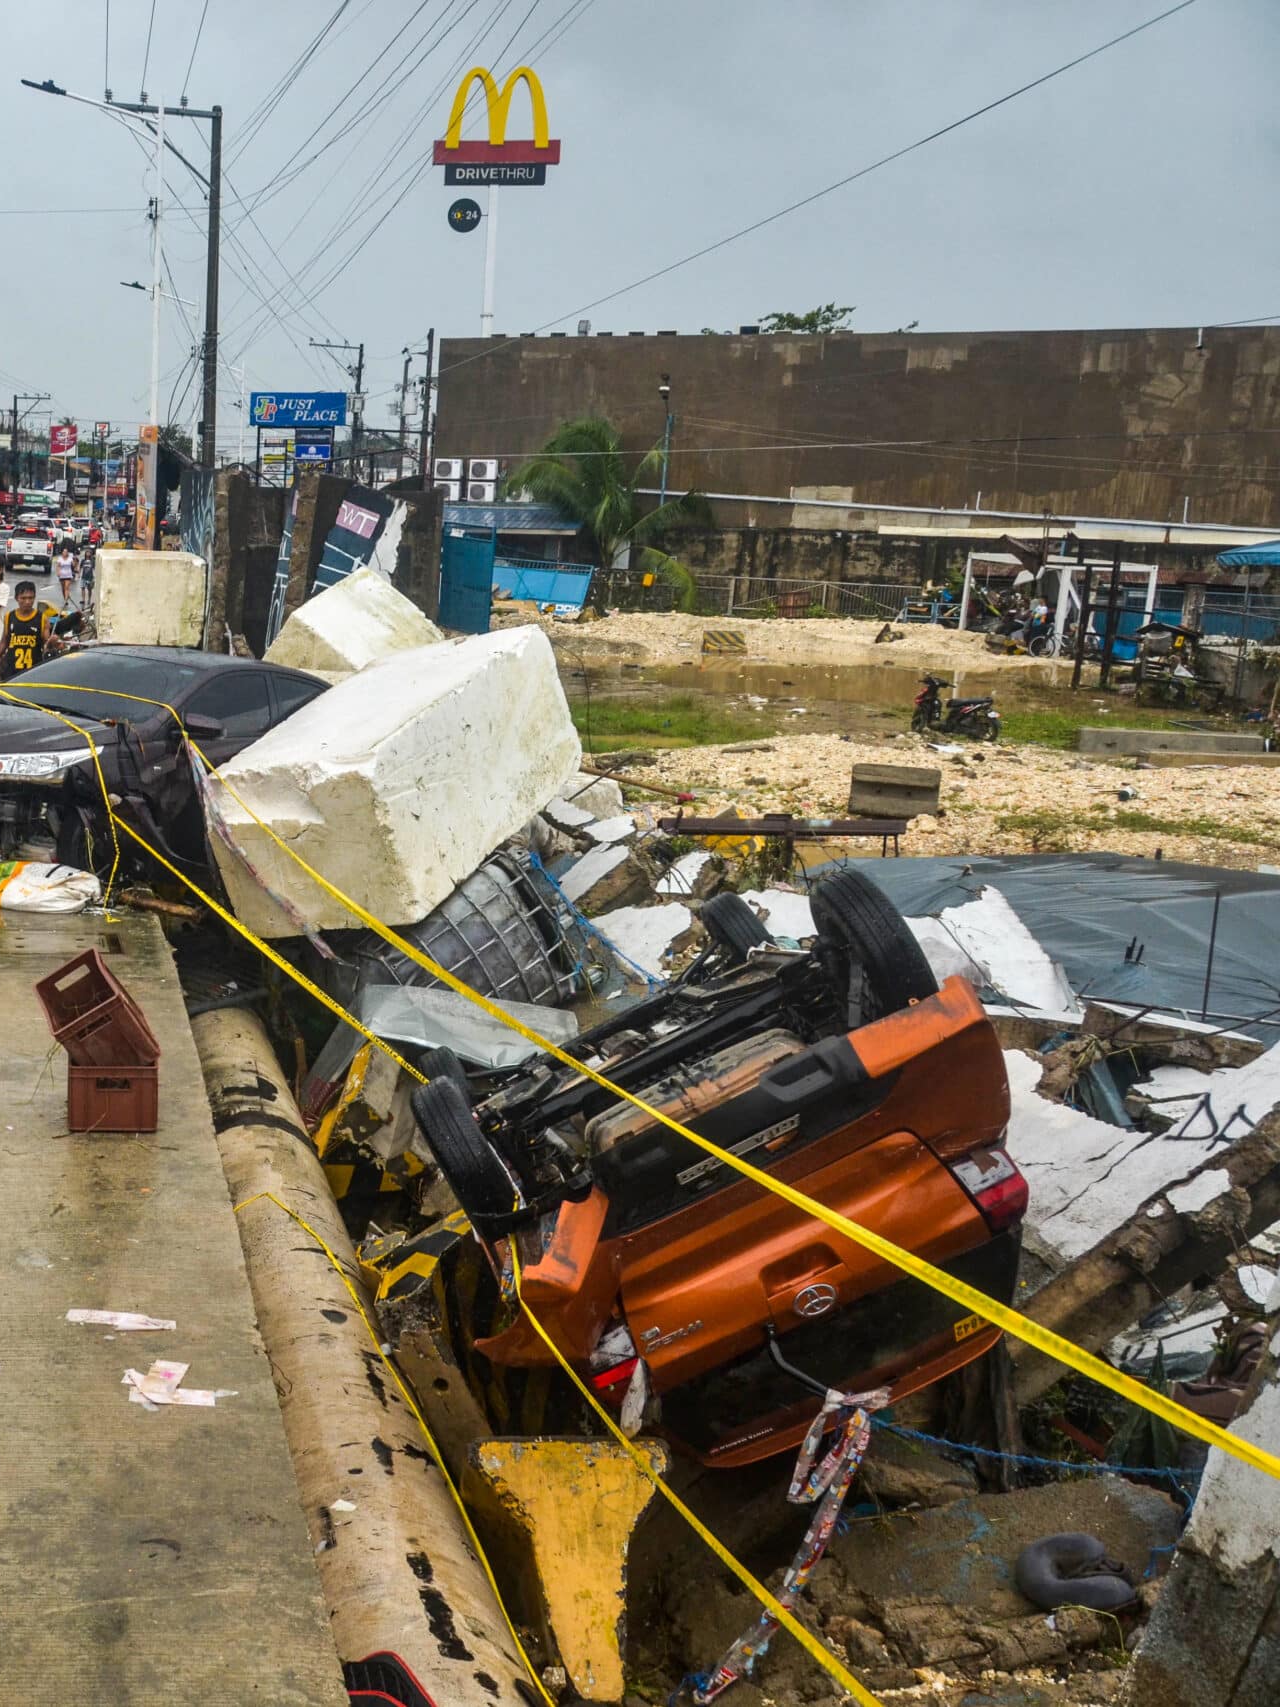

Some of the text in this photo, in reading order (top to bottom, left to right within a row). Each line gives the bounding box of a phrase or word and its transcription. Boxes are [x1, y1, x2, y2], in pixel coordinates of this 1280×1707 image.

[456, 168, 535, 179] DRIVETHRU
[465, 211, 478, 220] 24
[280, 399, 315, 410] JUST
[294, 411, 338, 421] PLACE
[9, 633, 37, 649] LAKERS
[15, 648, 33, 669] 24
